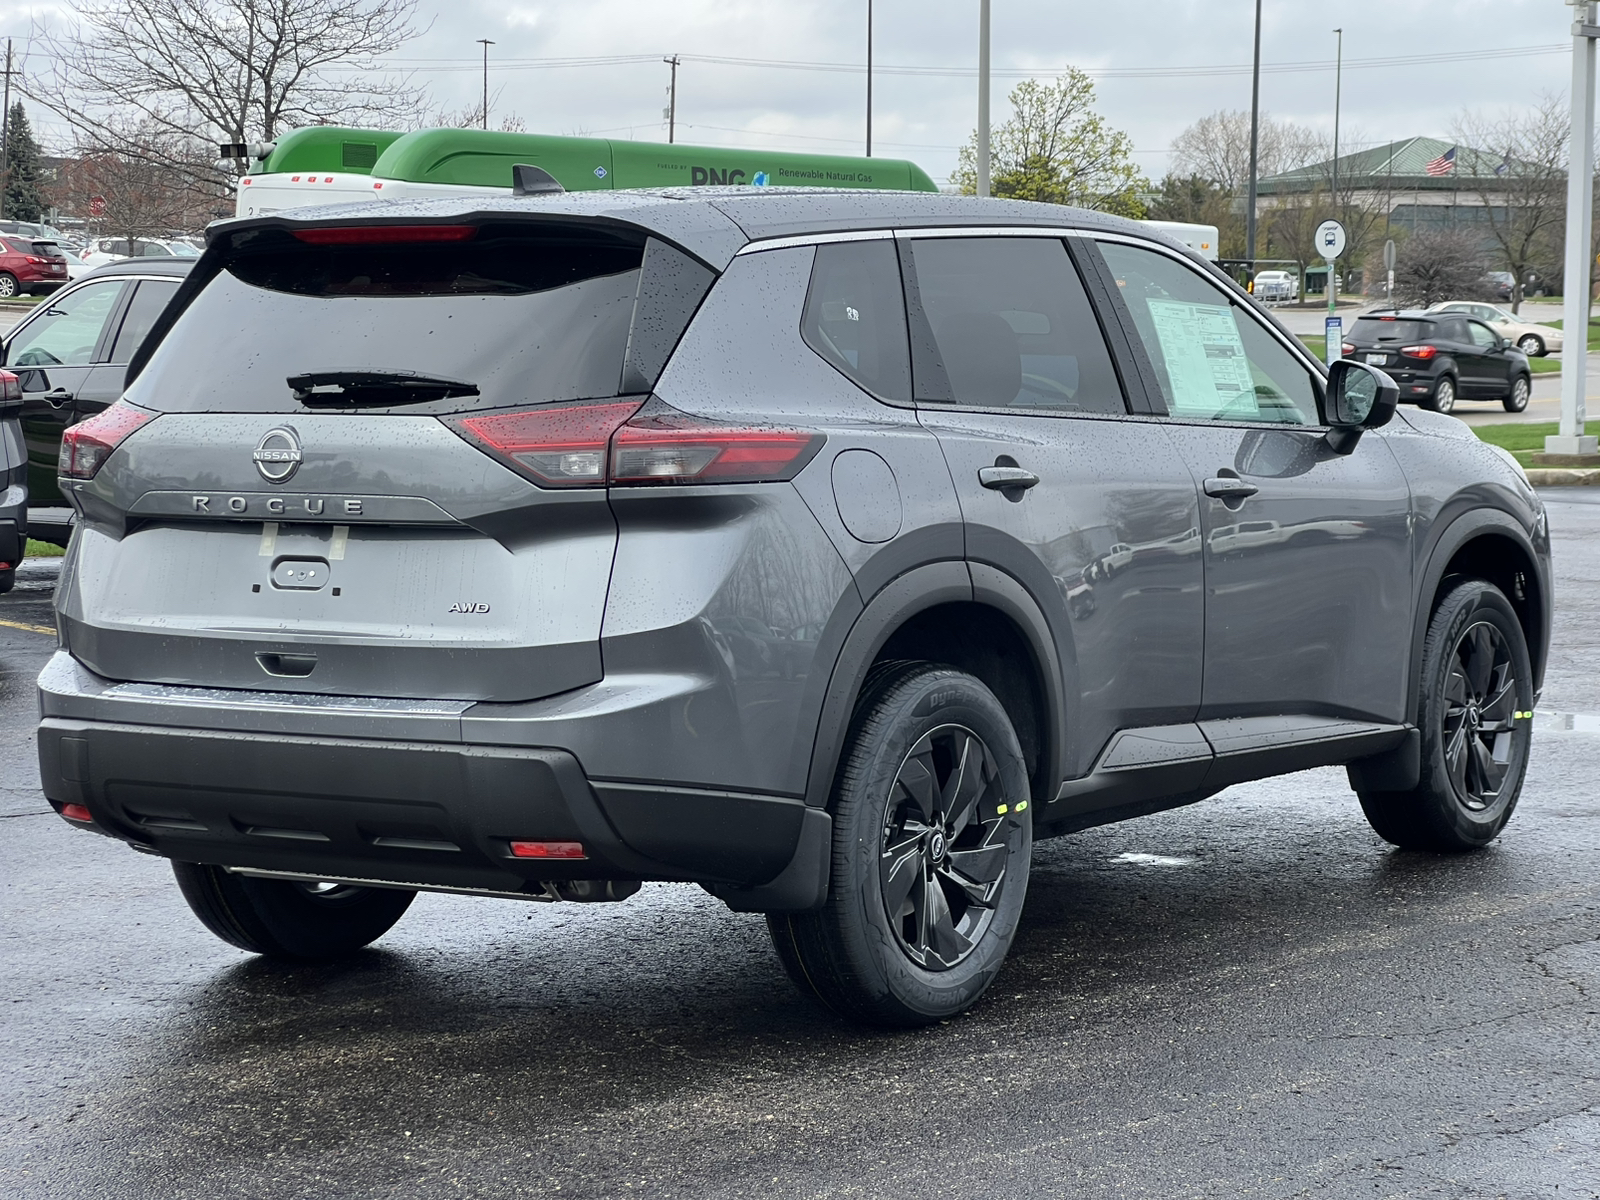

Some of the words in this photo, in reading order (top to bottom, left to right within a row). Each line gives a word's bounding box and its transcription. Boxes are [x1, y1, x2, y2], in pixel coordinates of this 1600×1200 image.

[779, 168, 824, 179] Renewable
[826, 171, 856, 181] Natural
[857, 173, 873, 182] Gas
[254, 451, 301, 461] NISSAN
[192, 496, 364, 515] ROGUE
[448, 602, 490, 614] AWD
